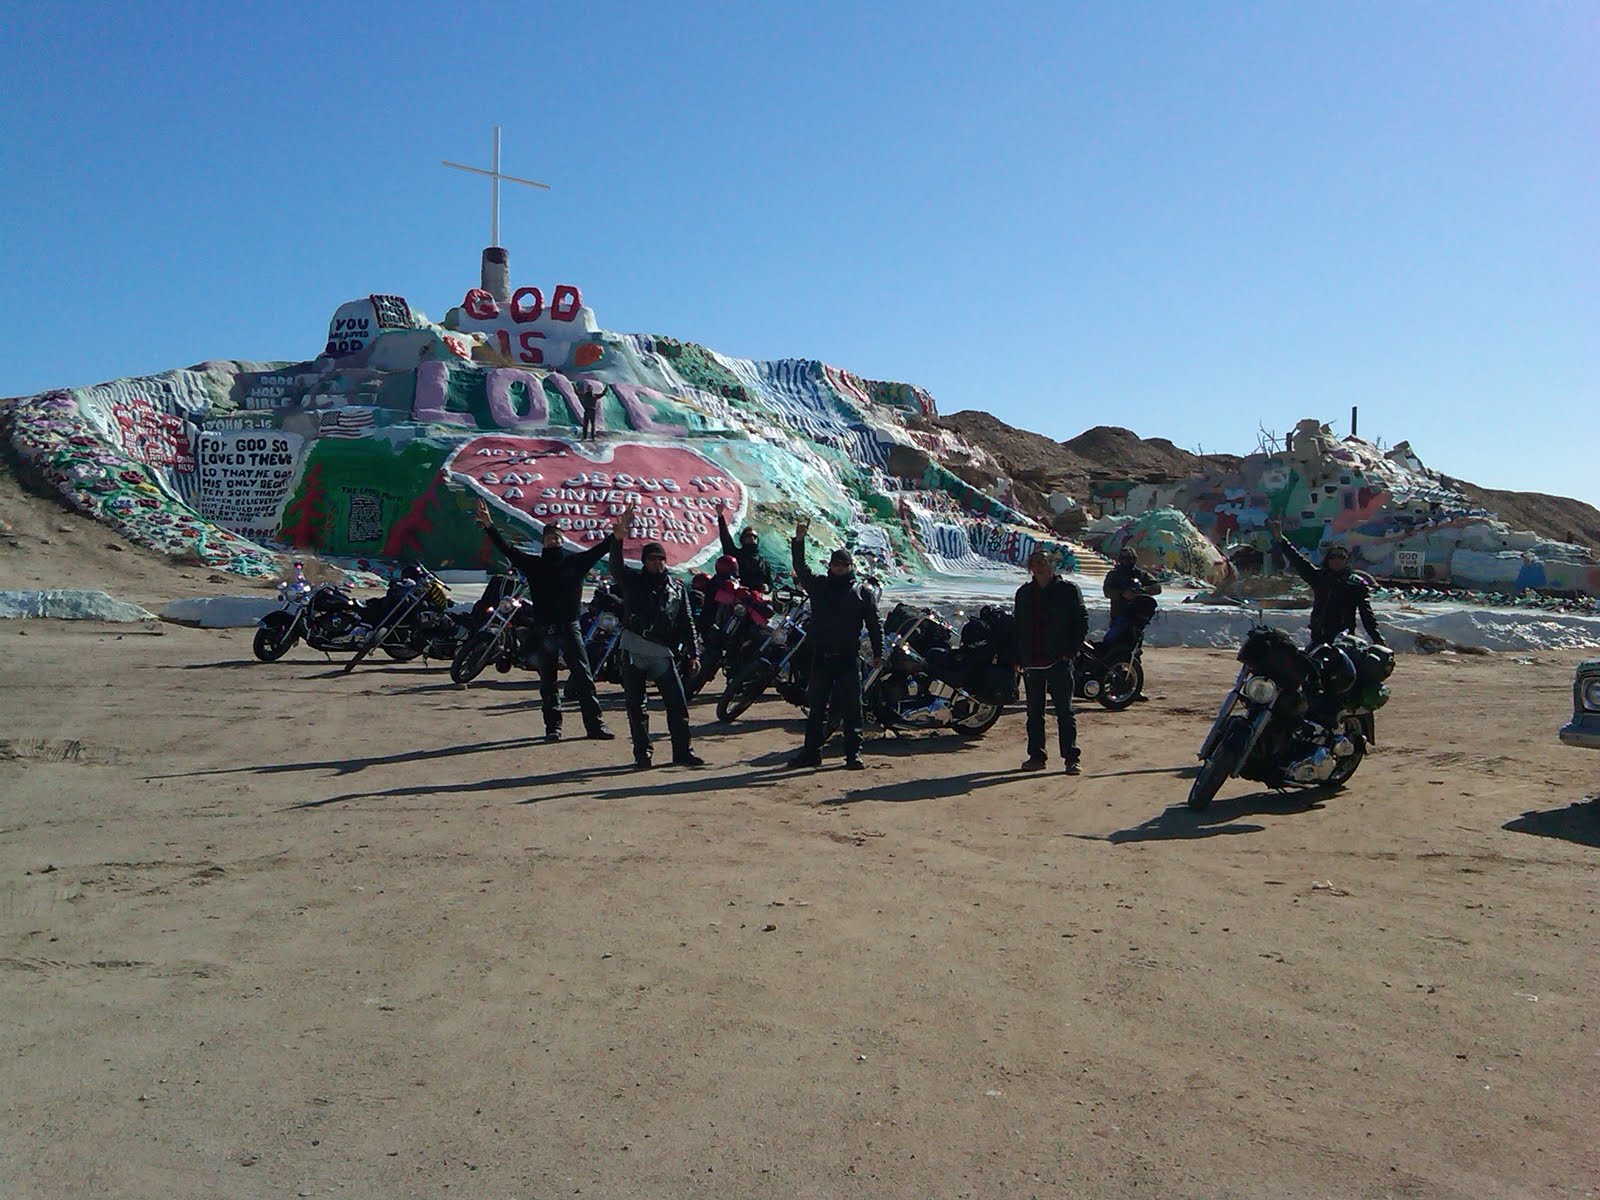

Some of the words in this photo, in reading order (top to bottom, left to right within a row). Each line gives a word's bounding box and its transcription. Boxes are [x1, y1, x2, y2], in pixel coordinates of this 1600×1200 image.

[463, 284, 583, 324] GOD
[336, 318, 369, 331] YOU
[343, 331, 369, 340] LOVED
[496, 329, 547, 364] IS
[251, 387, 285, 397] HOLY
[412, 360, 689, 437] LOVE
[246, 397, 292, 409] BIBLE
[206, 418, 243, 431] JOHN
[235, 438, 267, 452] GOD
[272, 439, 289, 452] SO
[201, 453, 246, 466] LOVED
[221, 468, 254, 478] THAT
[255, 469, 270, 478] HE
[202, 478, 222, 488] HIS
[227, 479, 257, 488] ONLY
[482, 471, 544, 485] SAY
[565, 470, 681, 493] JESUS
[228, 489, 250, 497] SON
[503, 486, 524, 499] A
[541, 487, 642, 504] SINNER
[653, 496, 737, 510] PLEASE
[534, 502, 598, 516] COME
[609, 503, 675, 519] UPON
[684, 509, 719, 526] MY
[558, 517, 614, 531] BODY
[629, 515, 659, 529] AND
[663, 517, 708, 535] INTO
[629, 527, 699, 545] HEART
[1398, 552, 1418, 560] GOD
